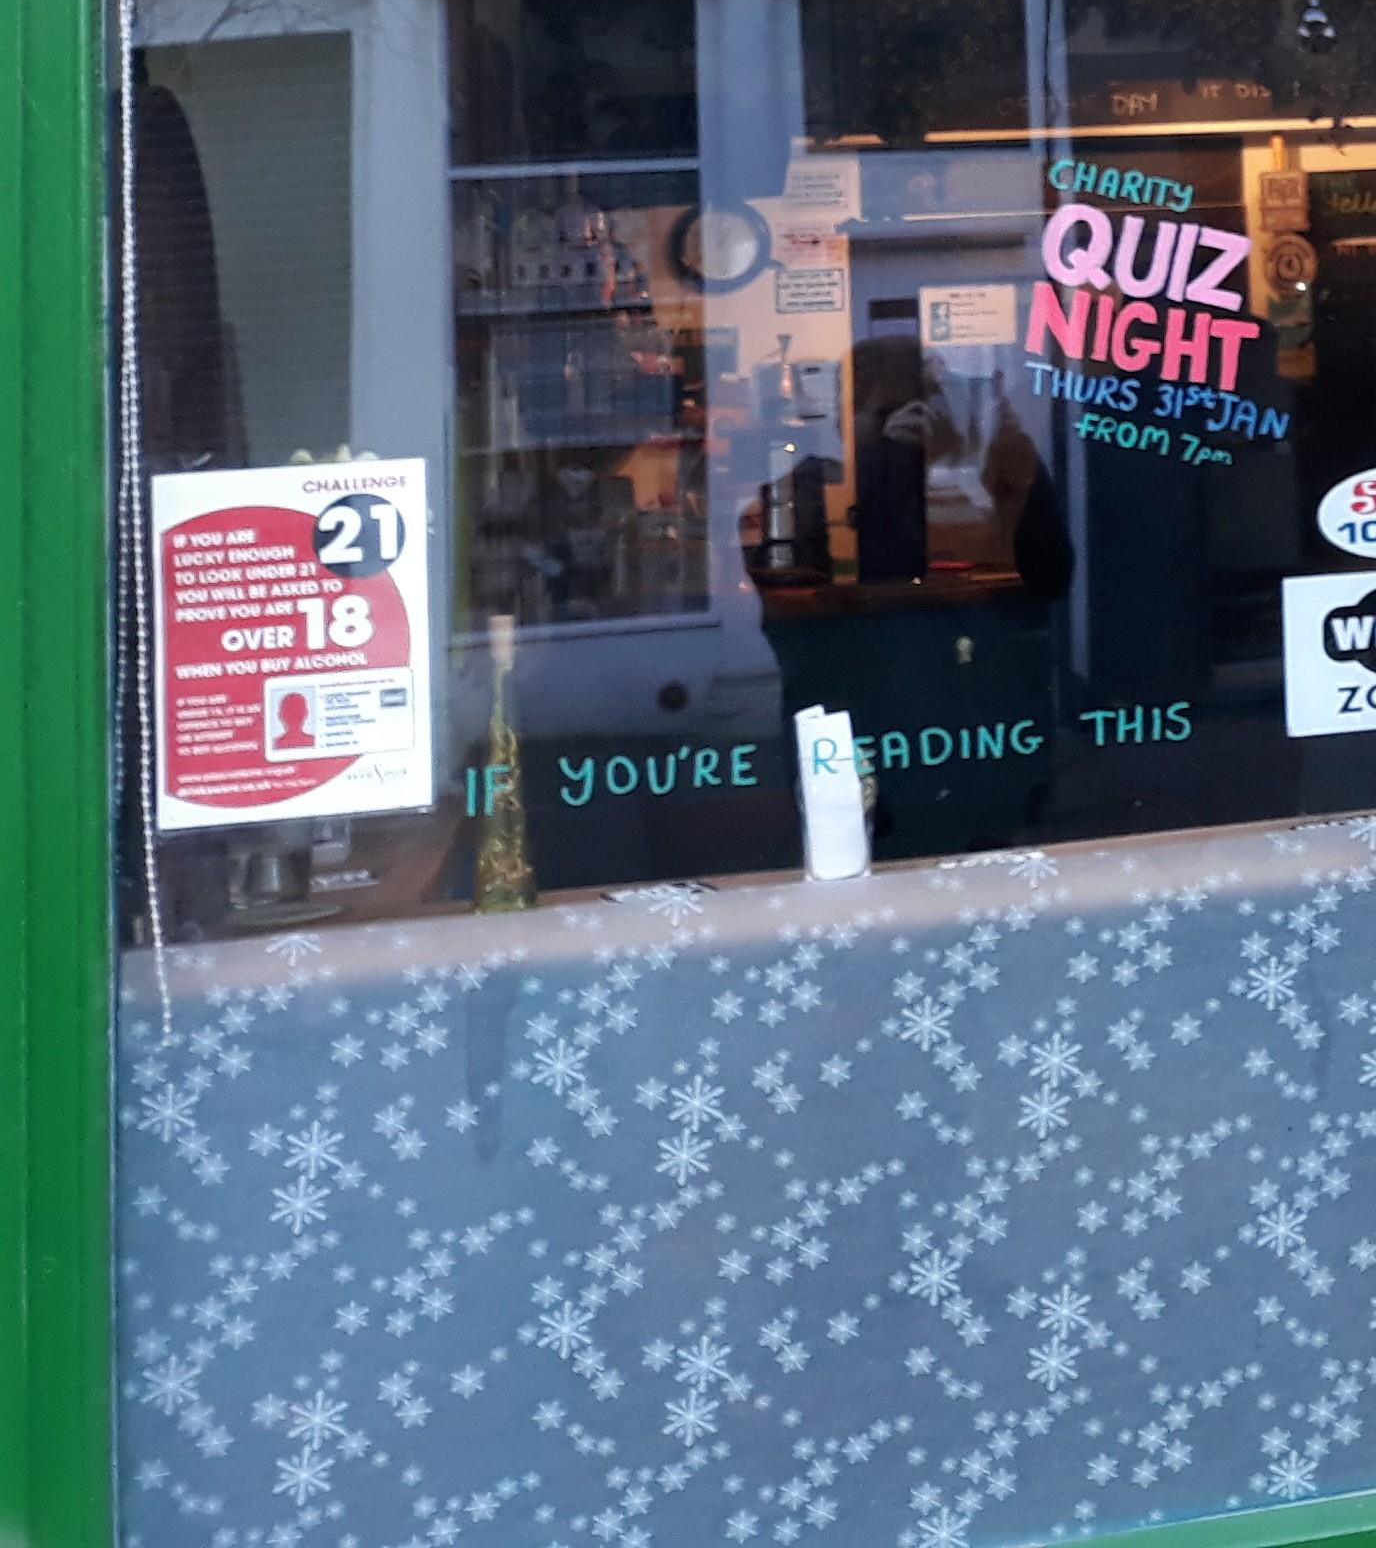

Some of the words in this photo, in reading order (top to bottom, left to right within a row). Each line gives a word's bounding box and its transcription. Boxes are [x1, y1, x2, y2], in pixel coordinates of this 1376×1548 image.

[1048, 158, 1194, 213] CHARITY
[1042, 203, 1252, 312] QUIZ
[1024, 280, 1259, 391] NIGHT
[1025, 360, 1141, 412] THURS
[1154, 383, 1215, 420] 31st
[1206, 393, 1290, 441] JAN
[1075, 413, 1170, 455] FROM
[1181, 433, 1233, 465] 7pm
[302, 476, 407, 494] CHALLENGE
[173, 534, 187, 548] IF
[191, 532, 223, 548] YOU
[226, 529, 256, 544] ARE
[173, 549, 225, 567] LUCKY
[228, 546, 295, 563] ENOUGH
[318, 505, 399, 565] 21
[175, 570, 196, 585] TO
[199, 567, 242, 584] LOOK
[246, 564, 296, 580] UNDER
[299, 563, 317, 576] 21
[175, 588, 209, 604] YOU
[212, 586, 244, 601] WILL
[249, 584, 267, 599] BE
[271, 580, 319, 596] ASKED
[323, 578, 343, 592] TO
[174, 605, 226, 623] PROVE
[230, 604, 260, 619] YOU
[265, 601, 293, 615] ARE
[220, 625, 294, 652] OVER
[297, 594, 373, 650] 18
[175, 662, 222, 679] WHEN
[226, 660, 257, 675] YOU
[260, 657, 290, 672] BUY
[295, 652, 369, 671] ALCOHOL
[464, 764, 509, 818] IF
[559, 743, 758, 808] YOU'RE
[812, 719, 1044, 777] READING
[1079, 701, 1192, 748] THIS
